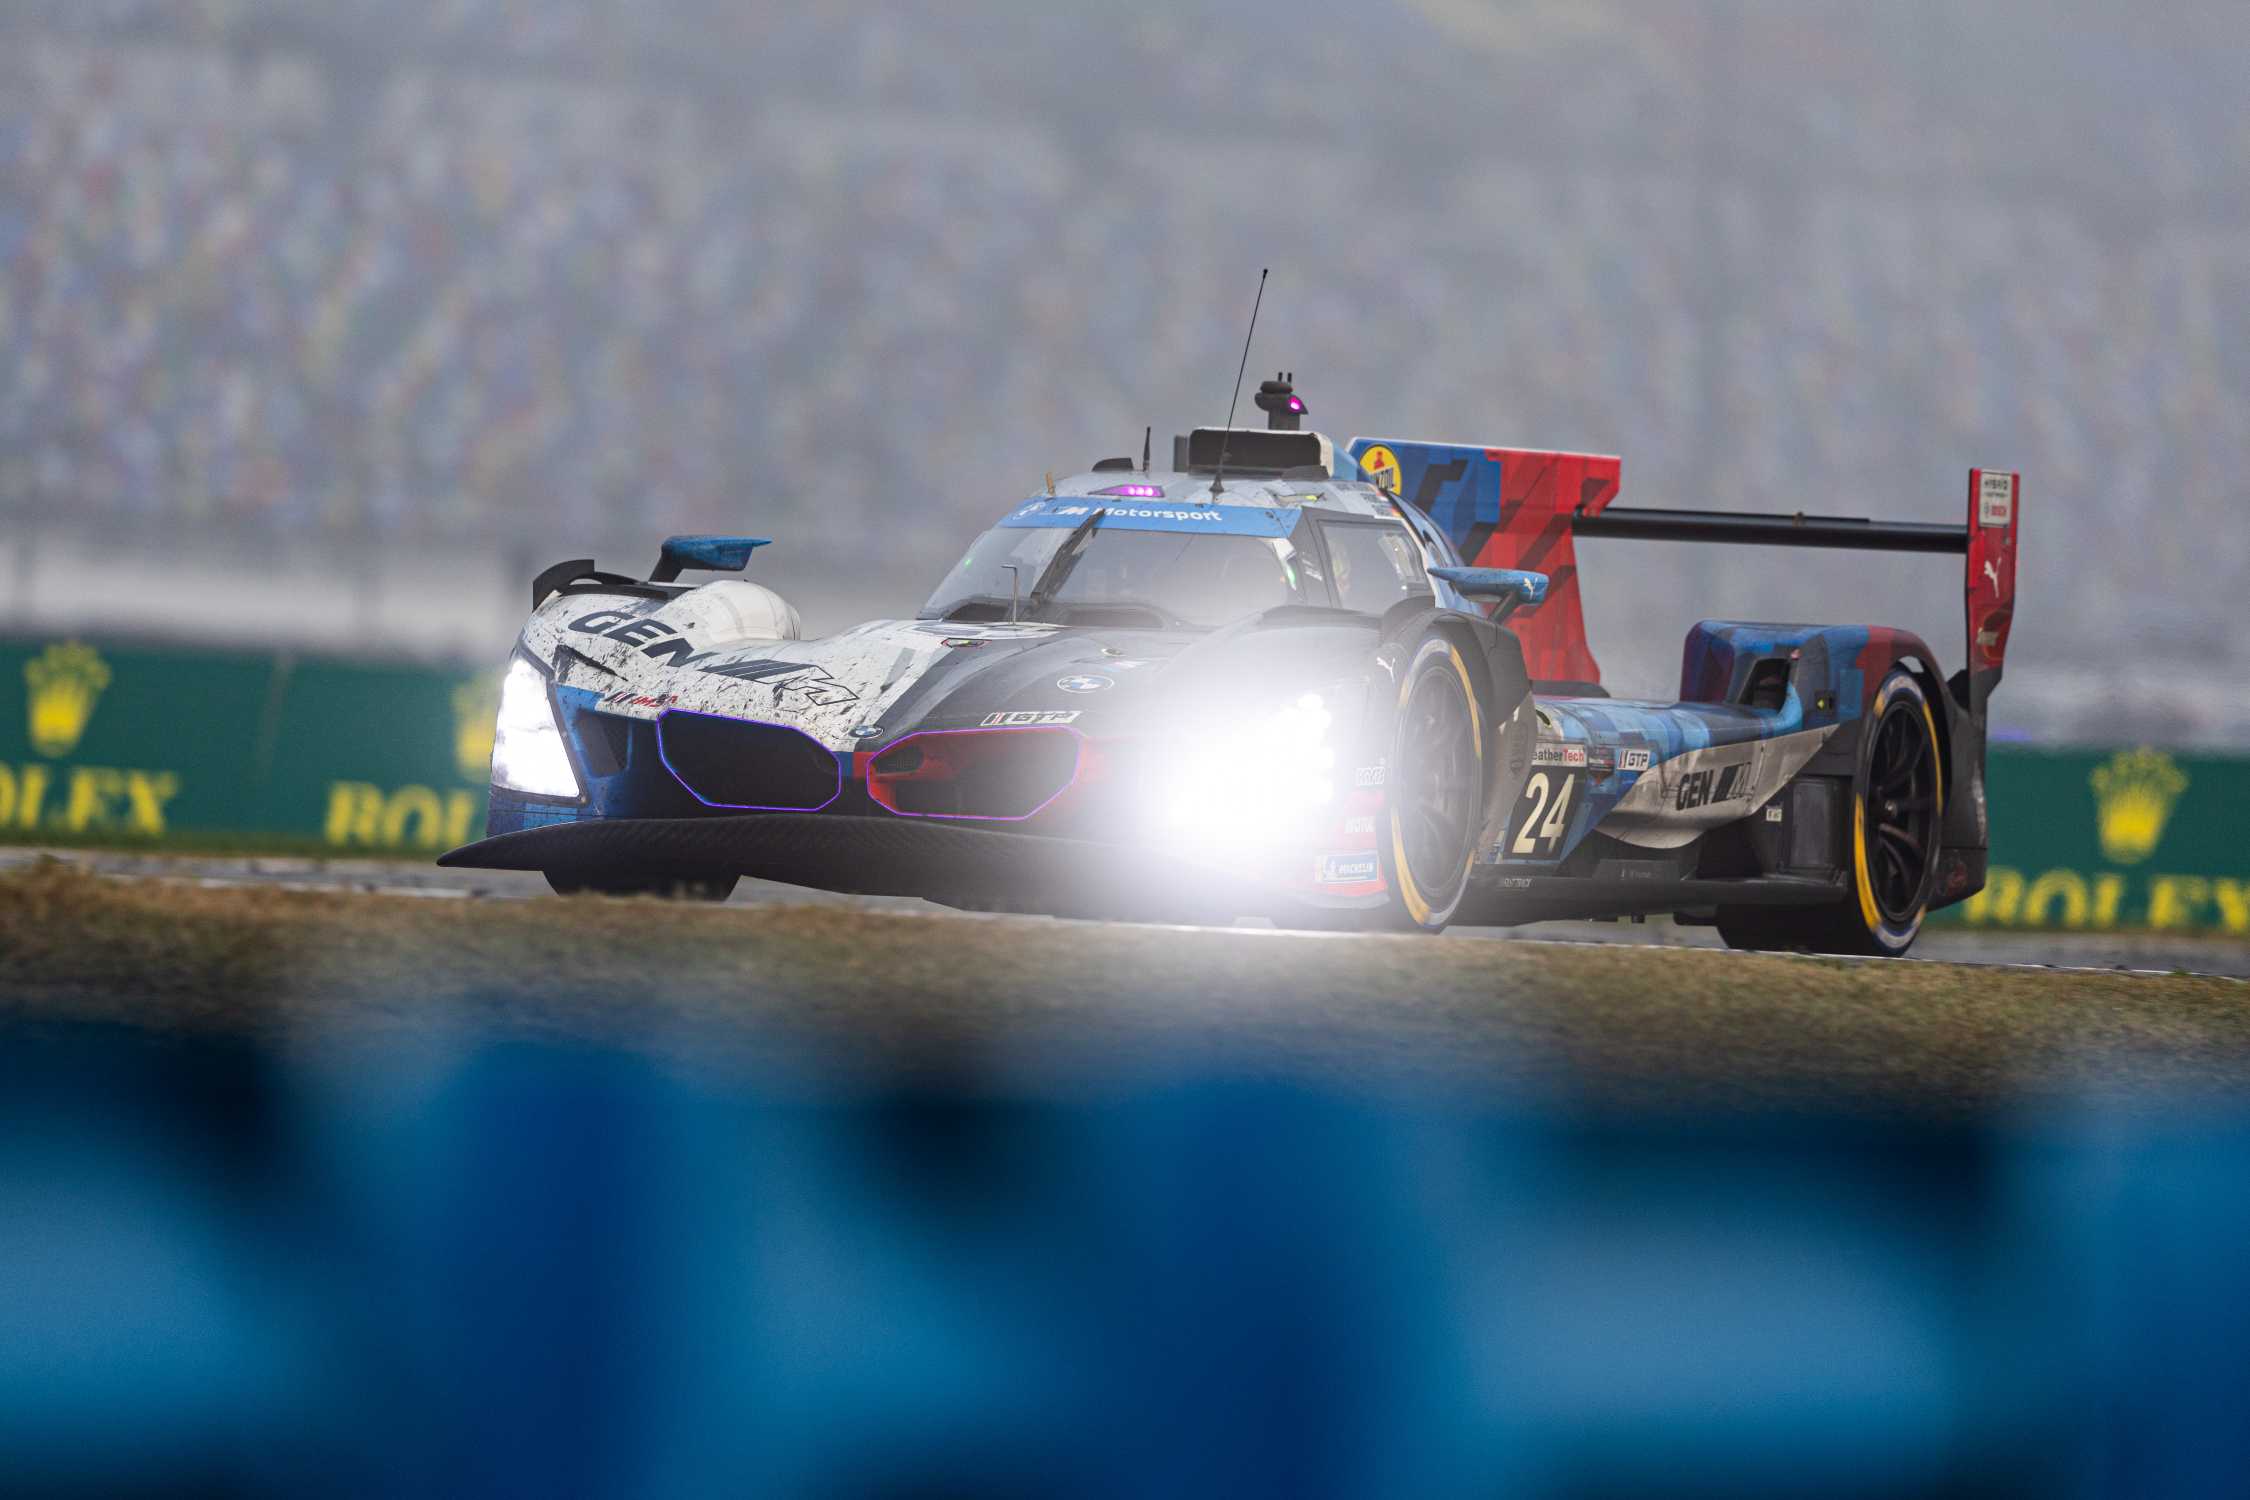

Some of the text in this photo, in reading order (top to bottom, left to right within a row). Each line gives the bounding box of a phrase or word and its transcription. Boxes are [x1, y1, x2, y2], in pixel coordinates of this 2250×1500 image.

[1092, 506, 1223, 522] Motorsport
[568, 610, 727, 668] GEN
[1533, 748, 1585, 763] eatherTech
[1627, 752, 1648, 767] GTP
[1676, 769, 1714, 811] GEN
[325, 780, 478, 847] ROL
[1511, 772, 1575, 854] 24
